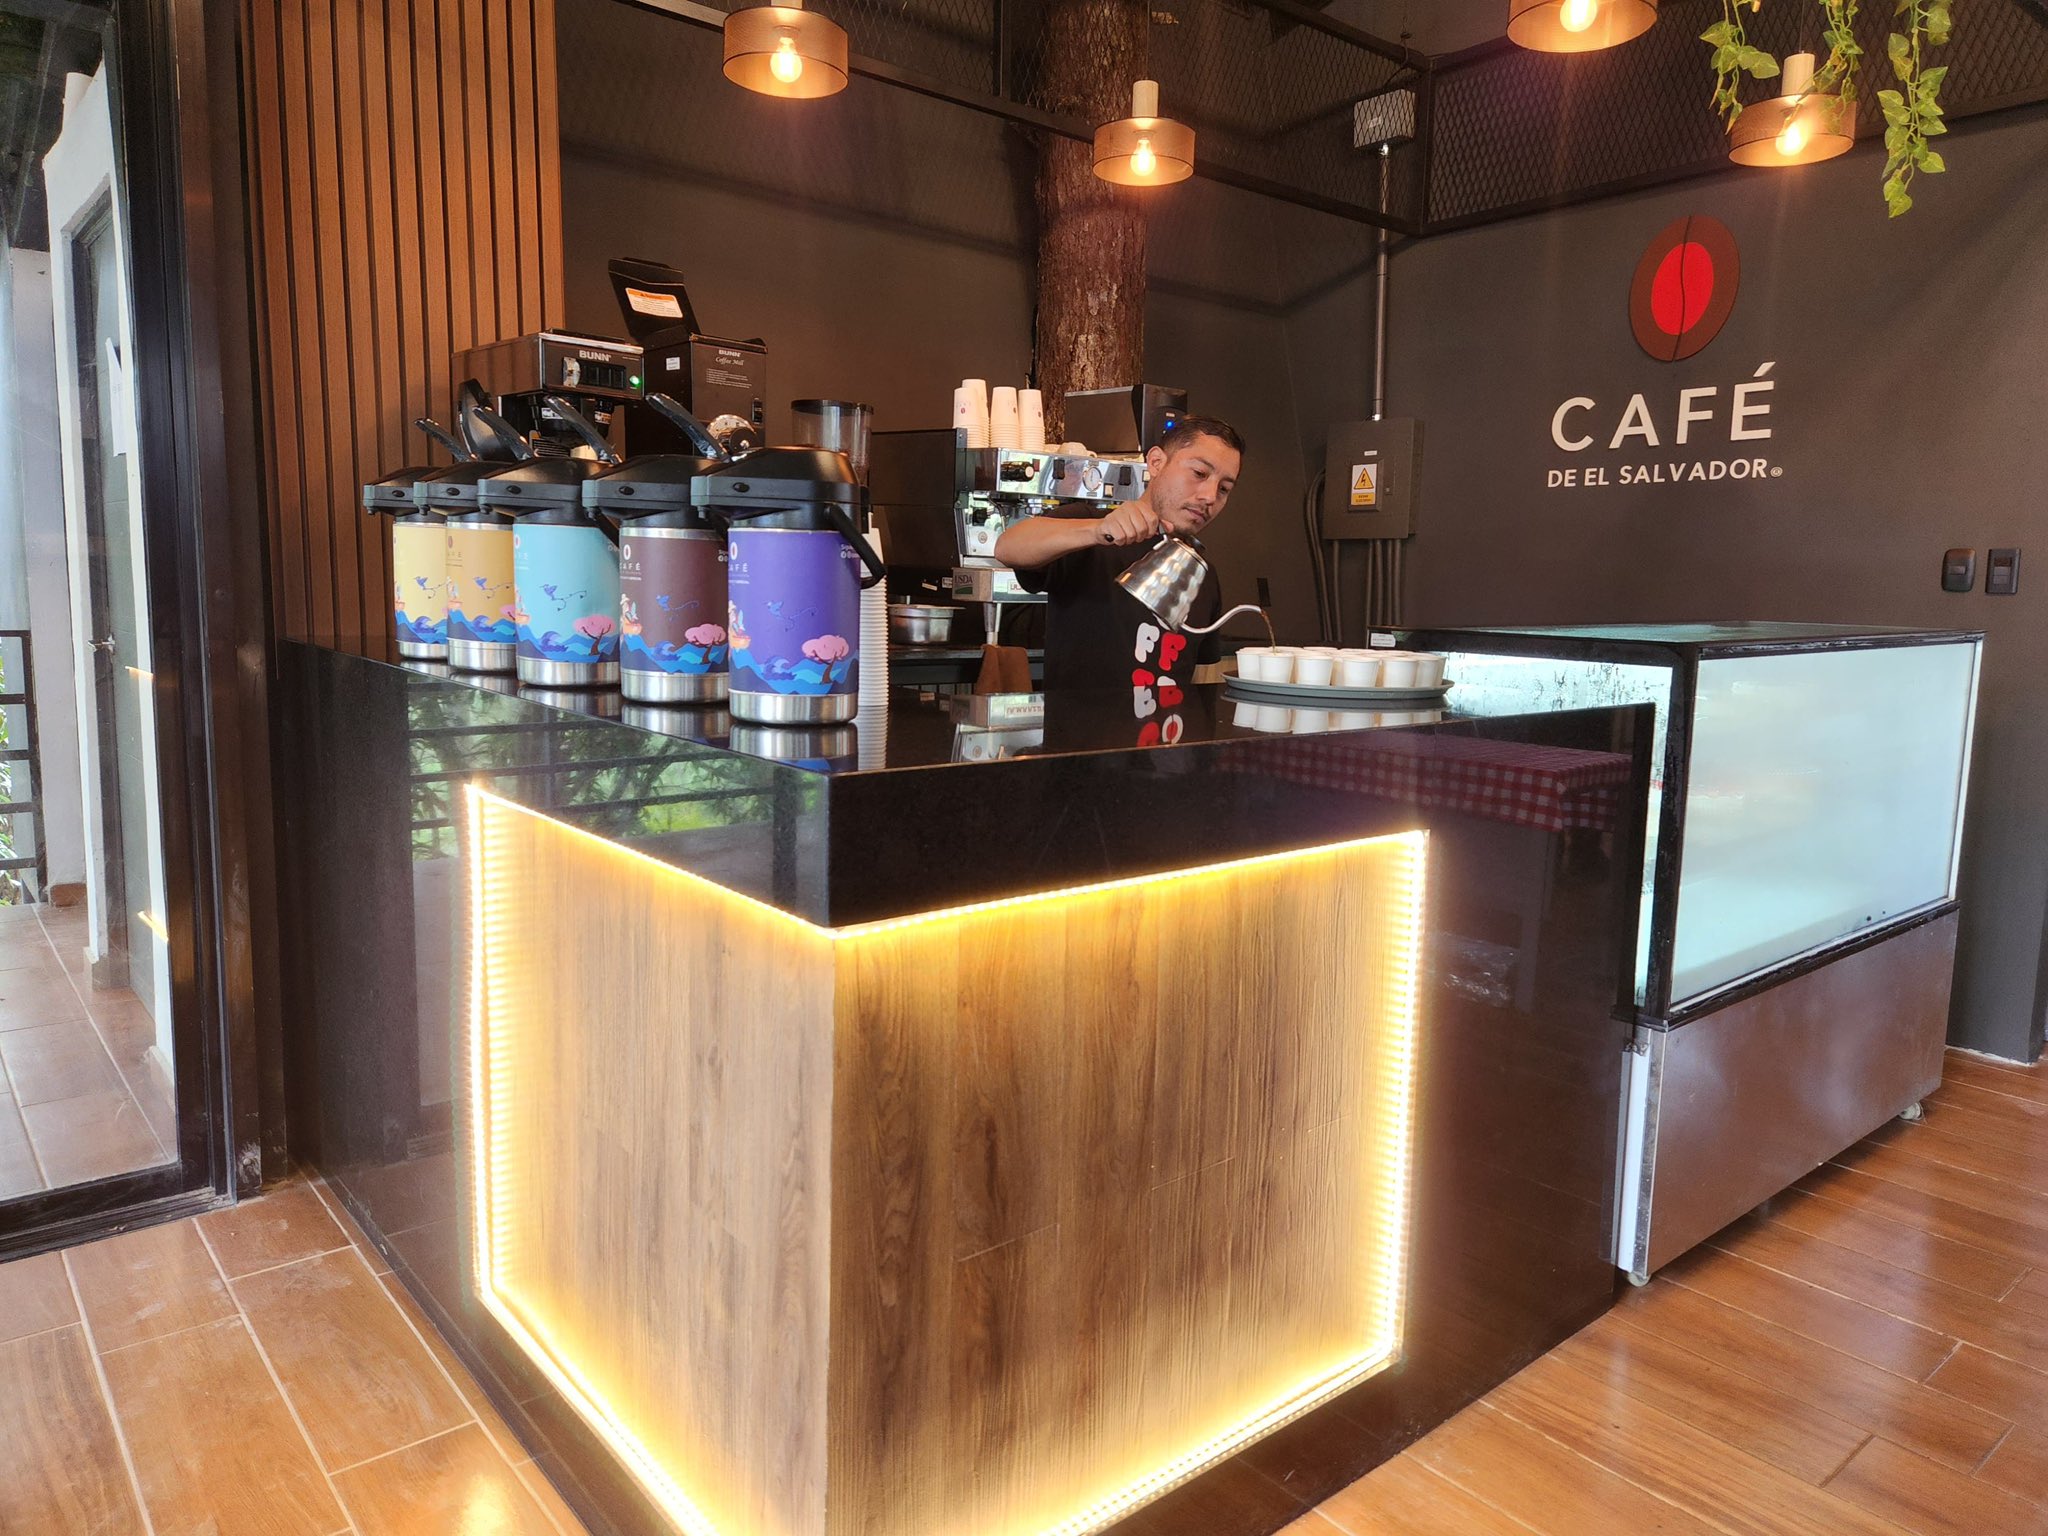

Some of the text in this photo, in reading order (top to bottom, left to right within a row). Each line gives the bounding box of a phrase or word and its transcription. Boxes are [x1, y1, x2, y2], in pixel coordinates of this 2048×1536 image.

[579, 350, 611, 362] BUNN
[718, 349, 742, 358] BUNN
[1551, 361, 1776, 452] CAFÉ
[1547, 468, 1577, 488] DE
[1584, 466, 1610, 487] EL
[954, 574, 973, 584] USDA
